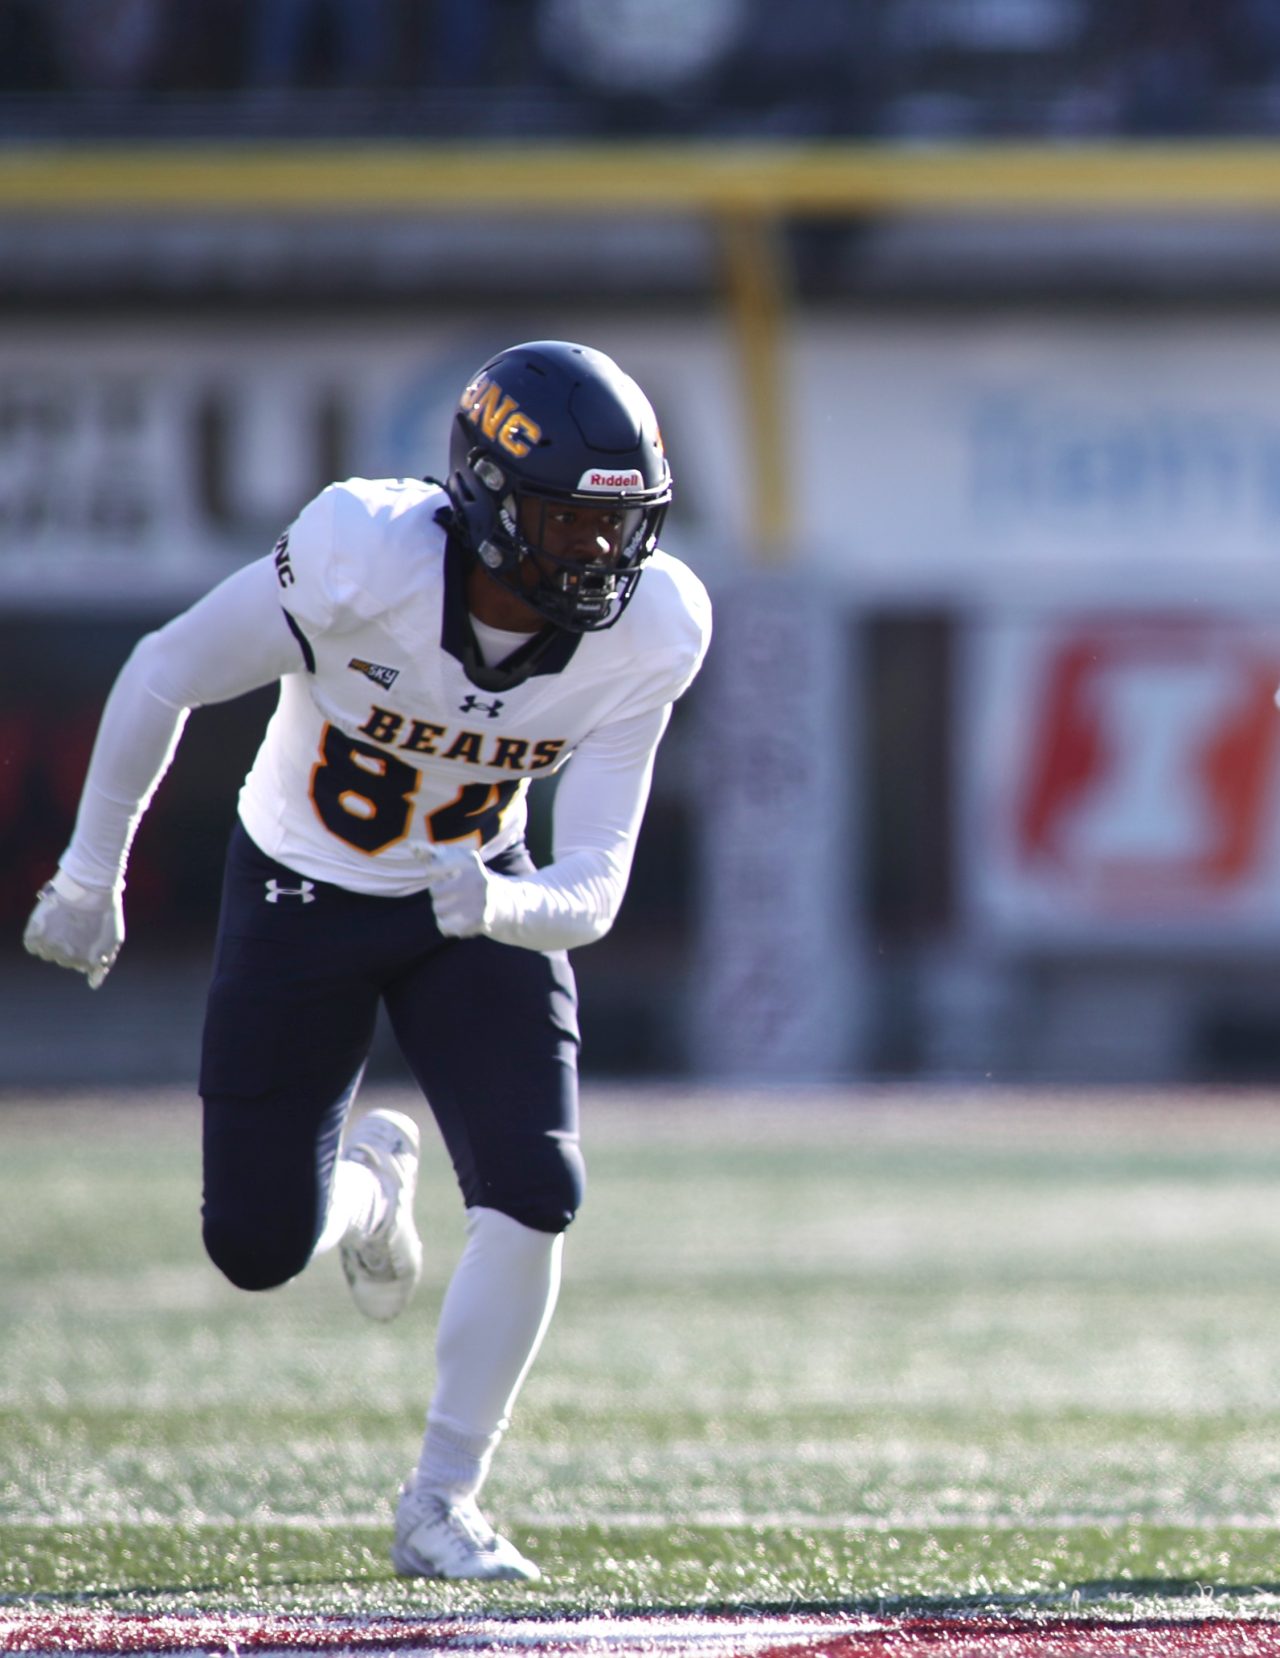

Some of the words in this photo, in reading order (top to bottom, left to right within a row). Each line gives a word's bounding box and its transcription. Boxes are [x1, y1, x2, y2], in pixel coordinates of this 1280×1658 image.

[591, 474, 638, 487] Riddell
[275, 533, 295, 588] NC
[357, 704, 568, 771] BEARS
[308, 719, 522, 857] 84
